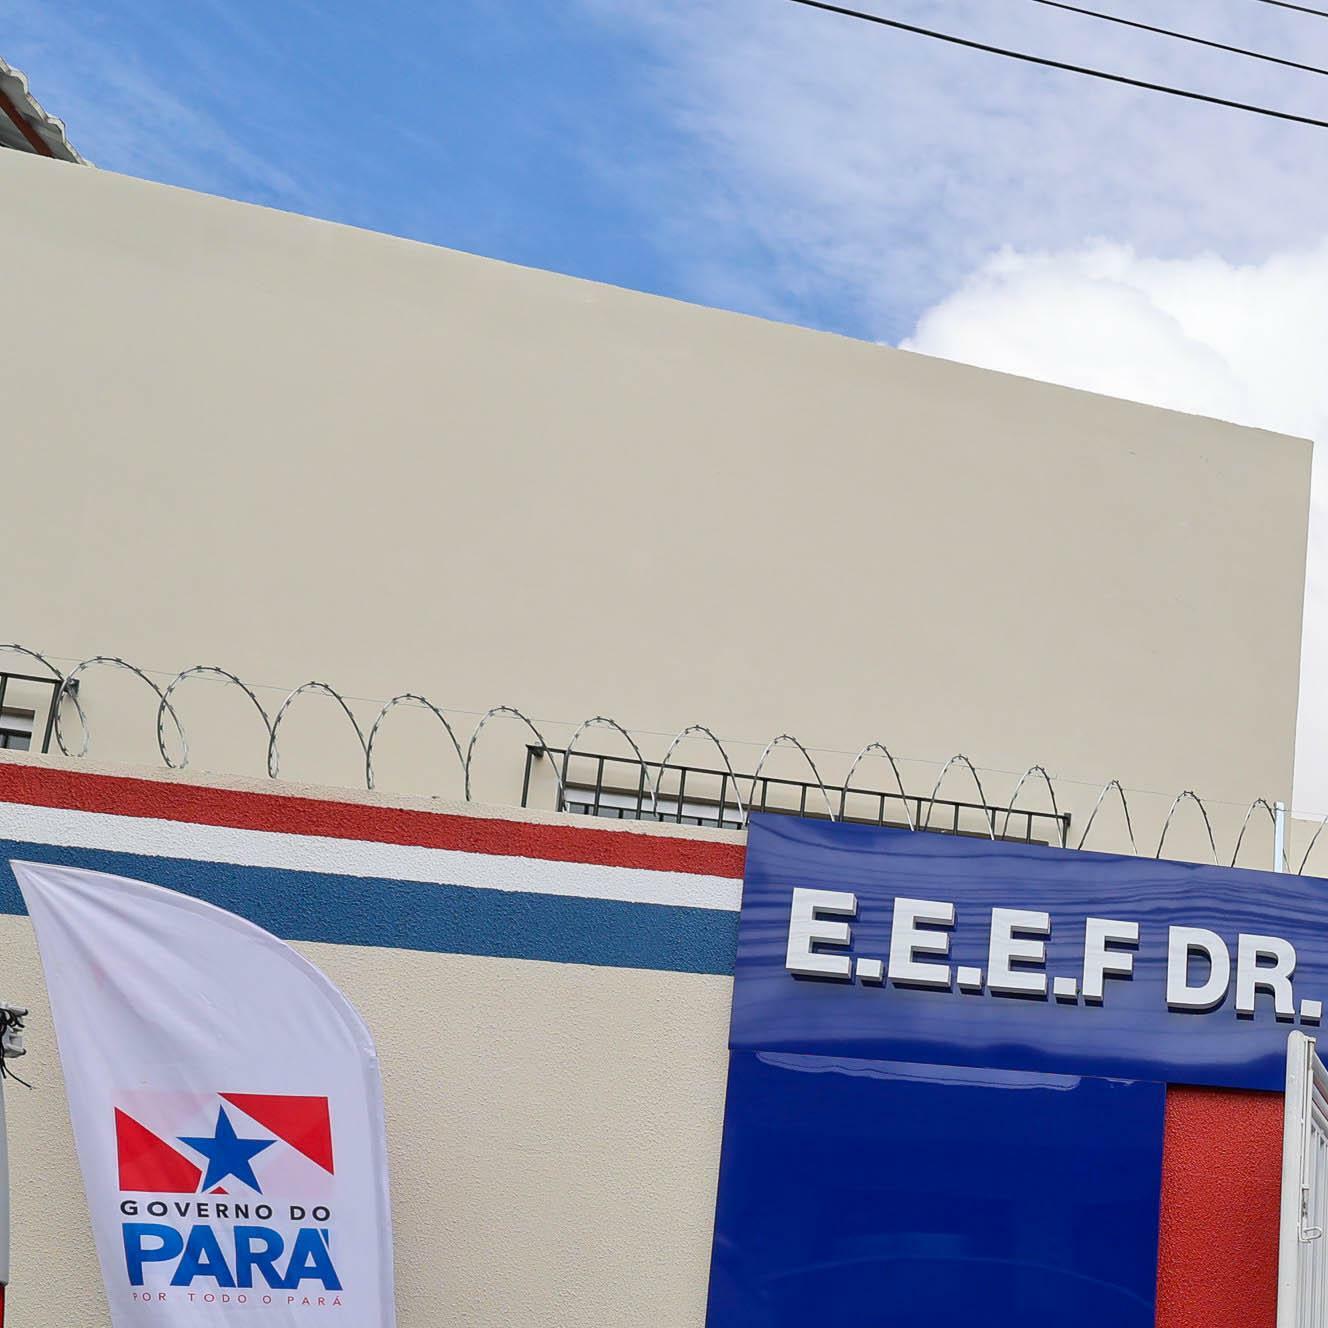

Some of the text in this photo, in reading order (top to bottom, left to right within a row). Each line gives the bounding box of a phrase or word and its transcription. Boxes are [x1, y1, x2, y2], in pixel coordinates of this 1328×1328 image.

[785, 887, 1140, 1002] E.E.E.F
[1166, 925, 1323, 1020] DR.
[120, 1200, 331, 1222] GOVERNO DO
[188, 1293, 247, 1304] TODO
[263, 1295, 272, 1305] O
[287, 1295, 343, 1307] PARÁ
